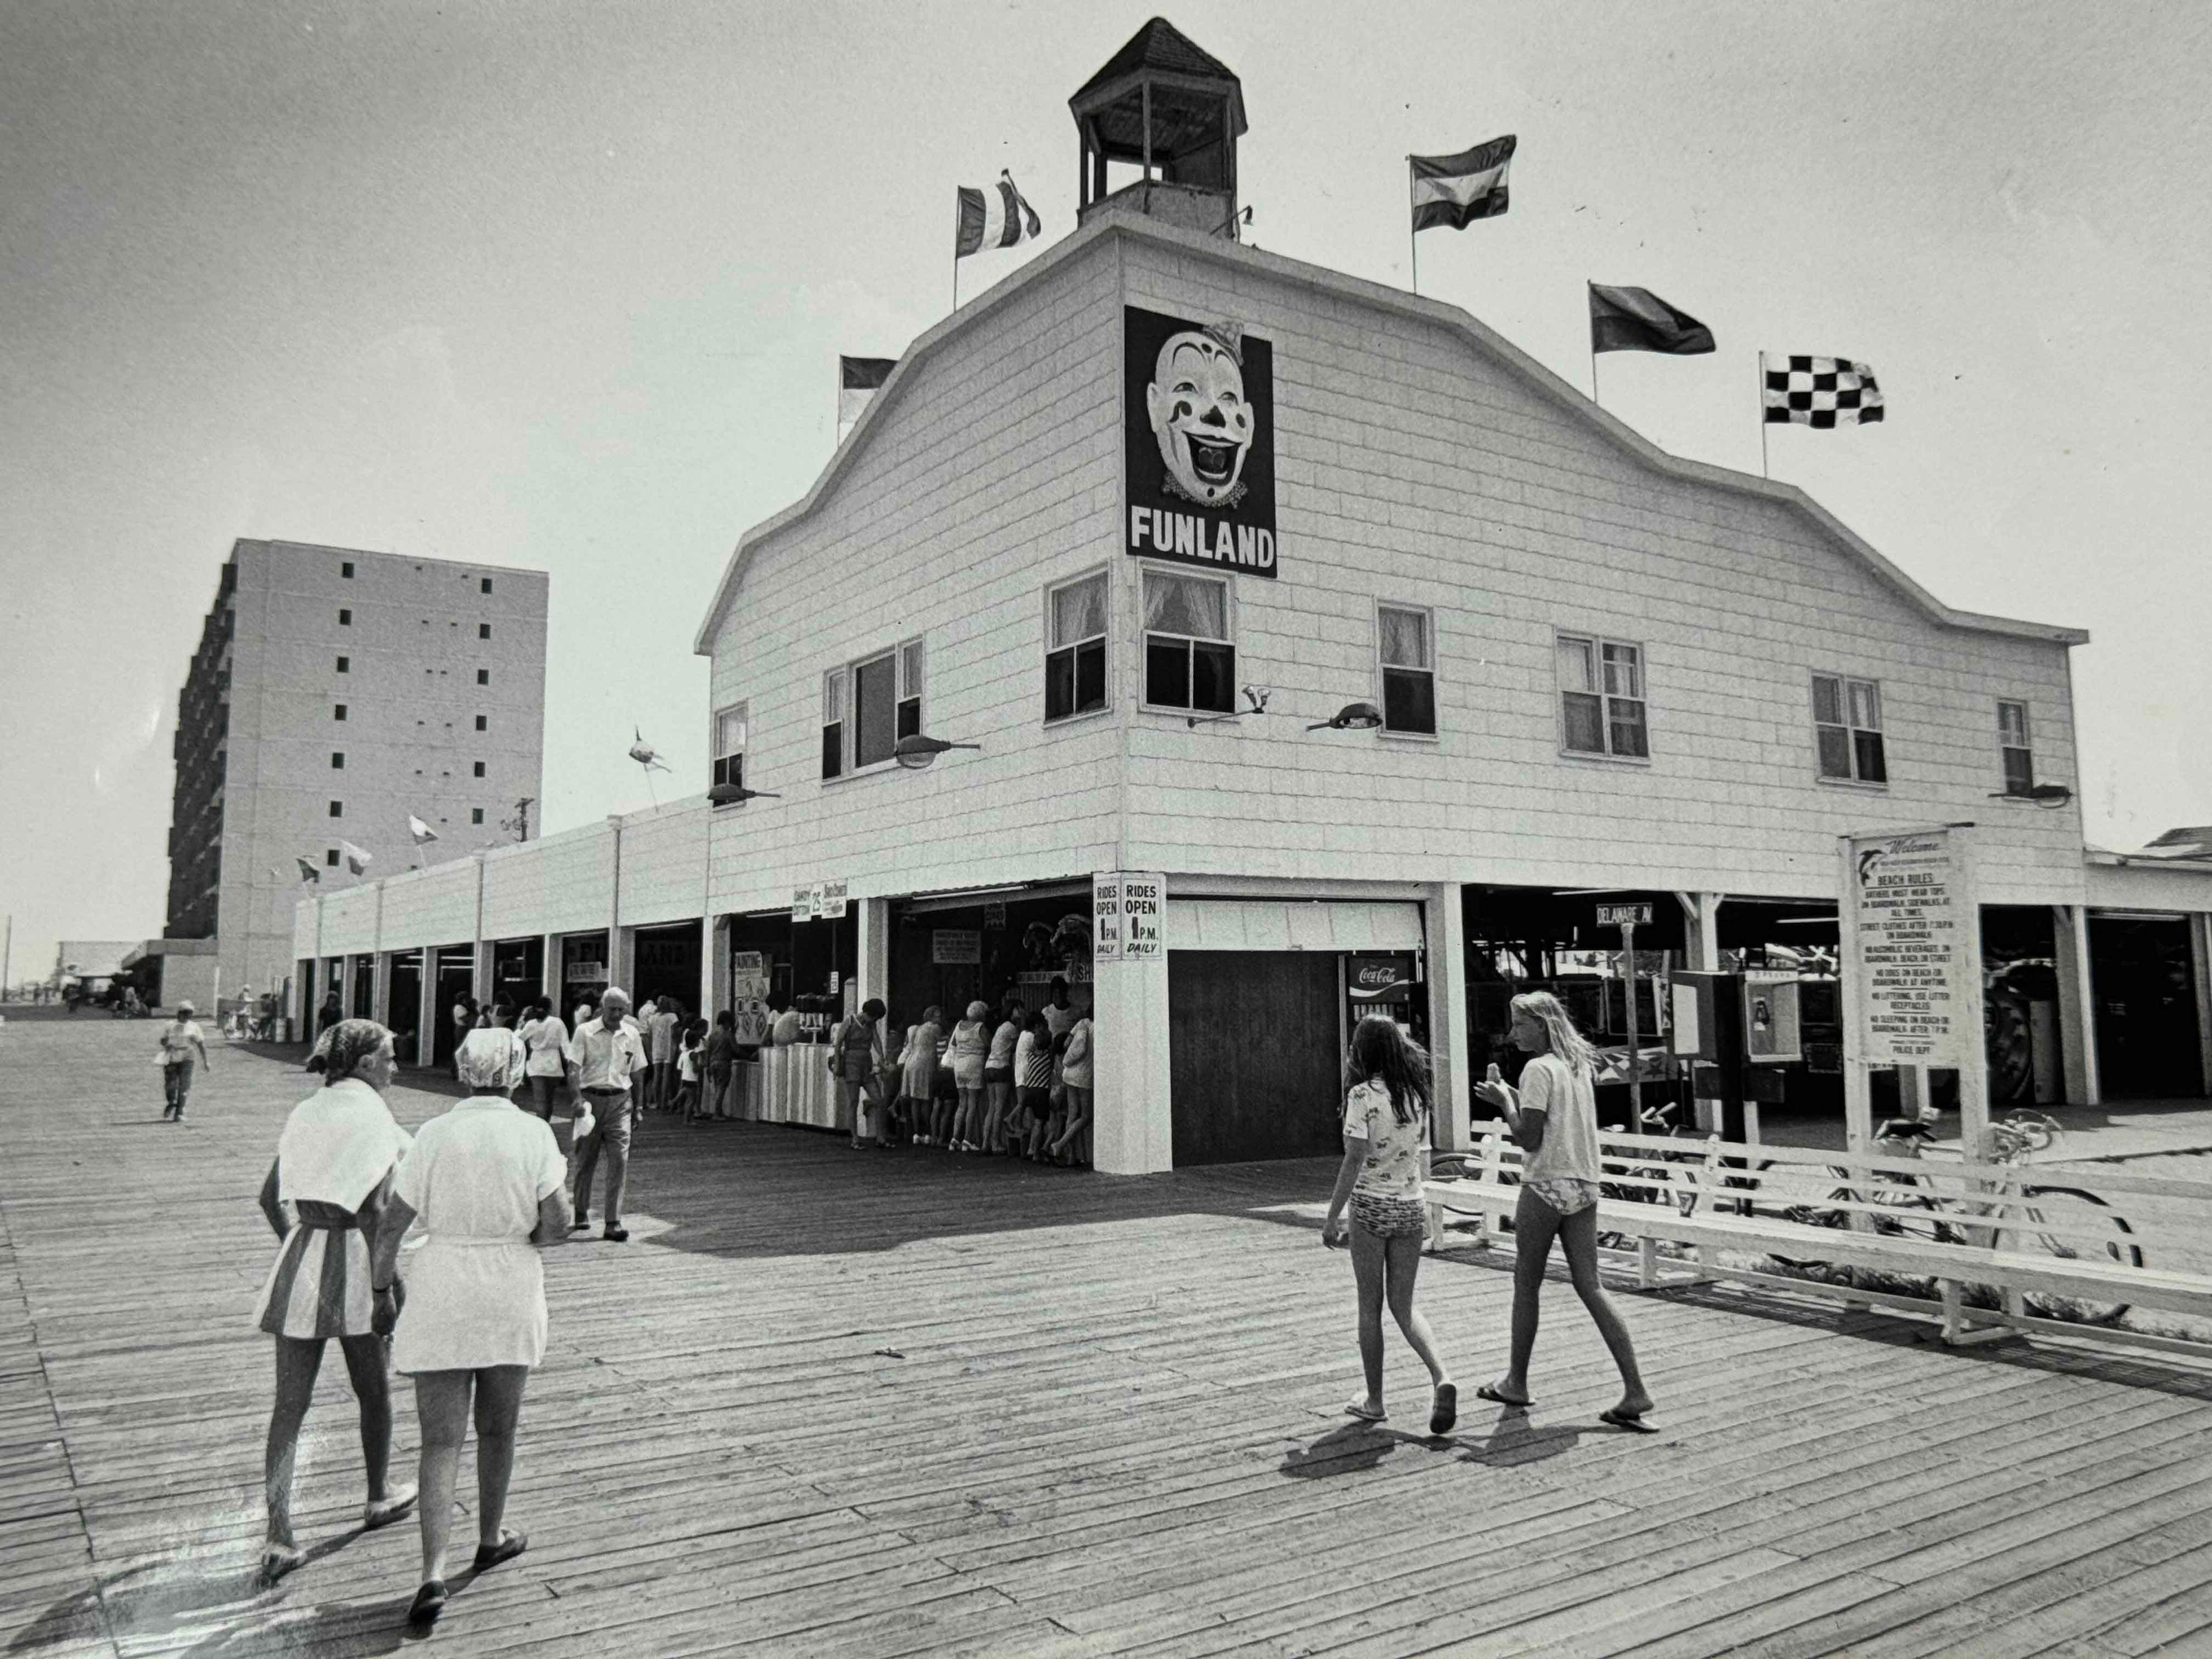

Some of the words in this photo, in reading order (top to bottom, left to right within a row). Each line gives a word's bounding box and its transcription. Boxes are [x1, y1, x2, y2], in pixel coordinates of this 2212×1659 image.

[1131, 504, 1275, 569] FUNLAND
[1885, 837, 1940, 854] Welcome
[1878, 875, 1904, 886] BEACH
[1907, 872, 1934, 884] RULES
[1097, 885, 1116, 899] RIDES
[1126, 885, 1156, 898] RIDES
[1125, 900, 1156, 914] OPEN
[1943, 897, 1950, 905] AT
[1096, 901, 1116, 915] OPEN
[1597, 906, 1637, 924] DELAWARE
[1101, 918, 1106, 941] 1
[1132, 917, 1139, 940] 1
[1859, 923, 1880, 931] STREET
[1097, 944, 1115, 953] DAILY
[1127, 943, 1157, 953] DAILY
[1905, 944, 1938, 953] BEVERAGES
[1930, 954, 1951, 963] STREET
[1880, 1015, 1907, 1024] SLEEPING
[1920, 1016, 1940, 1024] BEACH
[1893, 1046, 1914, 1054] POLICE
